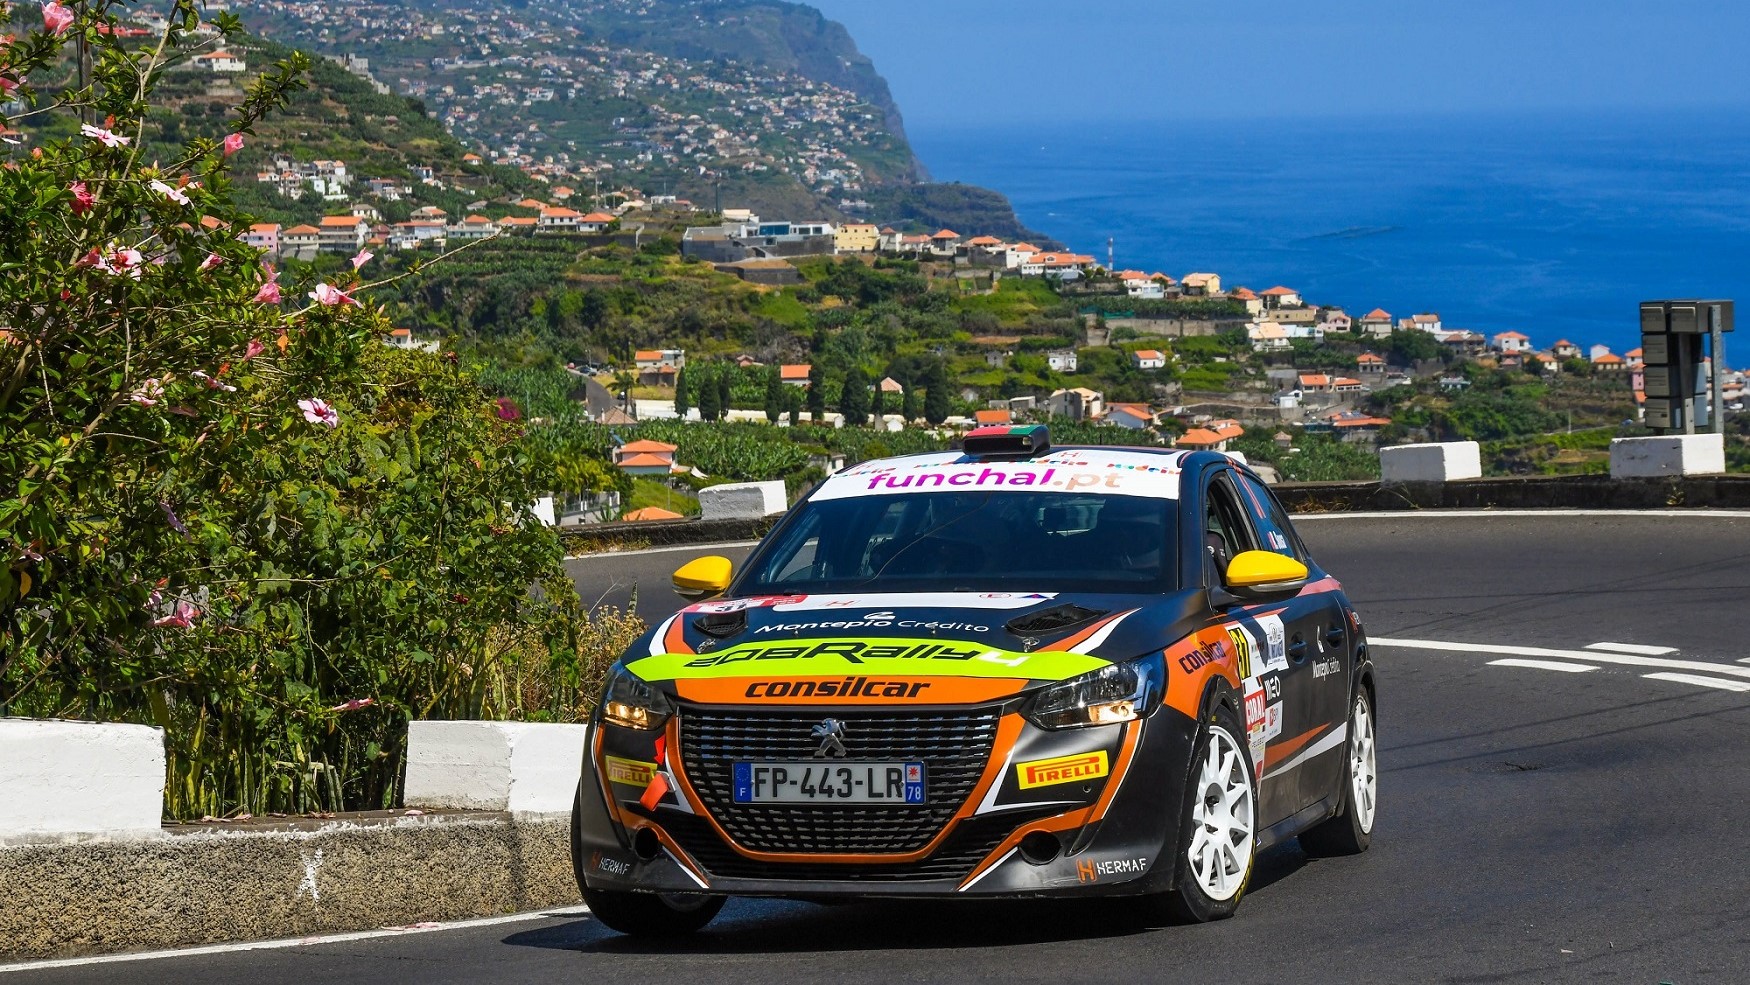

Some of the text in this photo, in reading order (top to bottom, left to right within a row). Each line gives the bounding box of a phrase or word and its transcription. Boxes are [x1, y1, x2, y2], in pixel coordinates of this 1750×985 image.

[867, 468, 1124, 491] funchal.pt
[754, 619, 990, 634] Montepio Crédito
[1178, 640, 1227, 675] consilcar
[744, 676, 932, 698] consilcar
[1245, 693, 1265, 726] CORAL
[609, 761, 651, 784] PIRELLI
[1025, 756, 1100, 785] PIRELLI
[739, 787, 746, 797] F
[754, 767, 903, 799] FP-443-LR
[907, 786, 921, 800] 78
[599, 857, 631, 876] HERMAF
[1096, 858, 1147, 875] HERMAF
